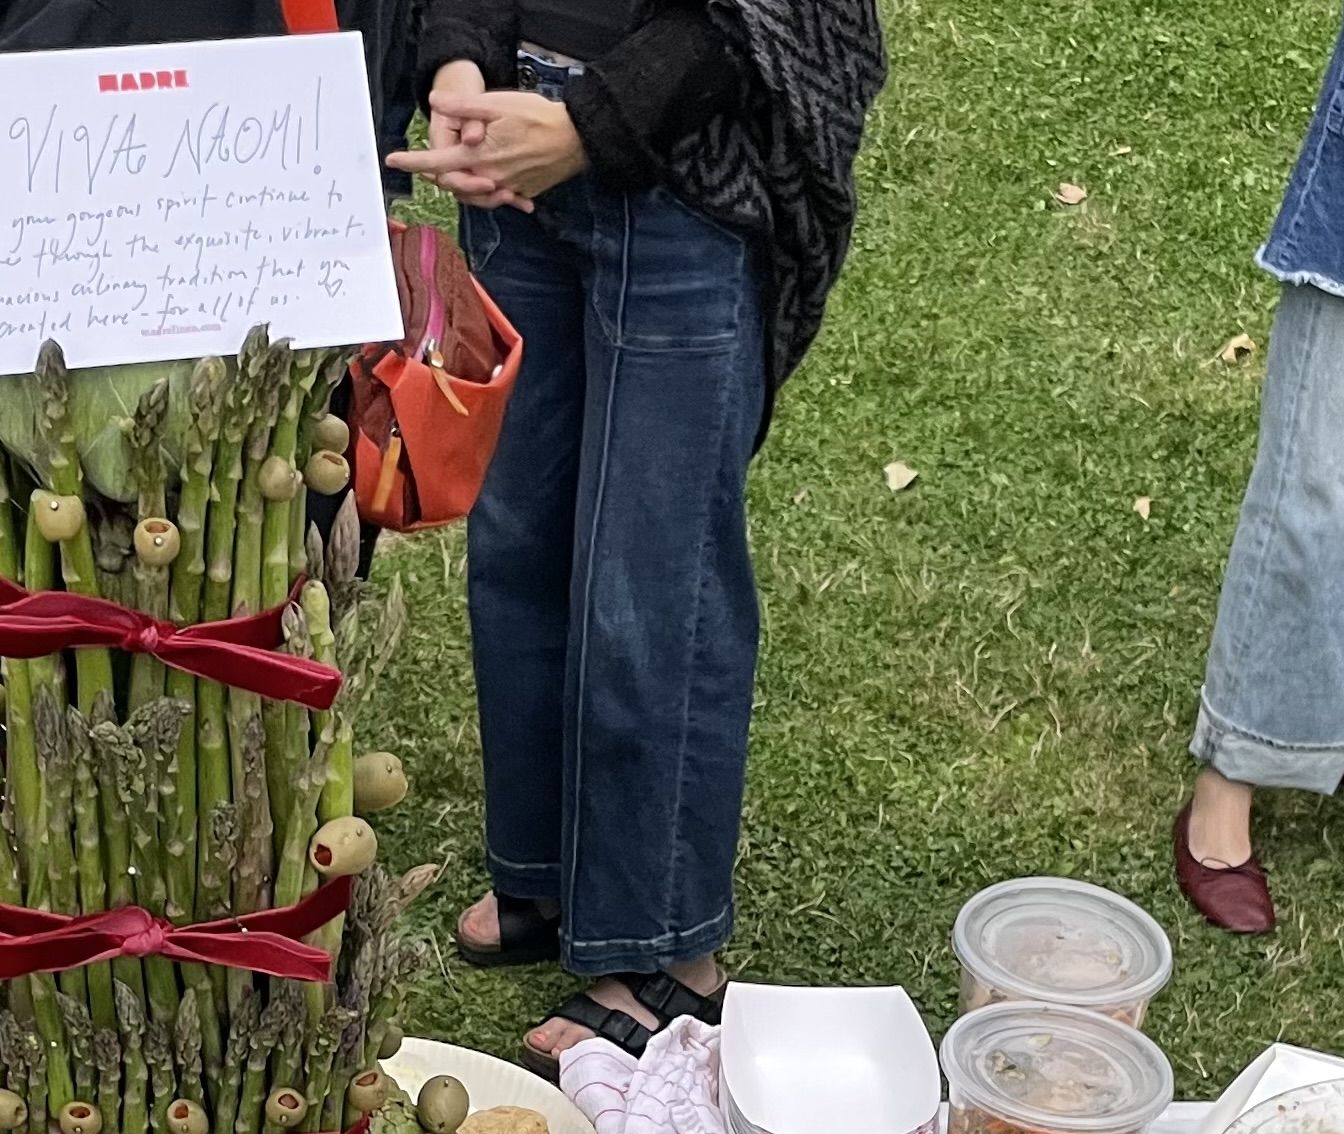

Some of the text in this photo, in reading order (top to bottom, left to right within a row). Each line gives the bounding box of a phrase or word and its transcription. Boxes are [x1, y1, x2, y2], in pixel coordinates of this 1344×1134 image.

[98, 69, 190, 93] MADRE
[9, 215, 56, 254] your
[156, 183, 217, 222] spirit
[327, 179, 343, 209] to
[125, 233, 160, 258] the
[156, 263, 248, 291] tradition
[256, 255, 306, 286] that
[87, 304, 129, 329] here
[156, 293, 189, 331] for
